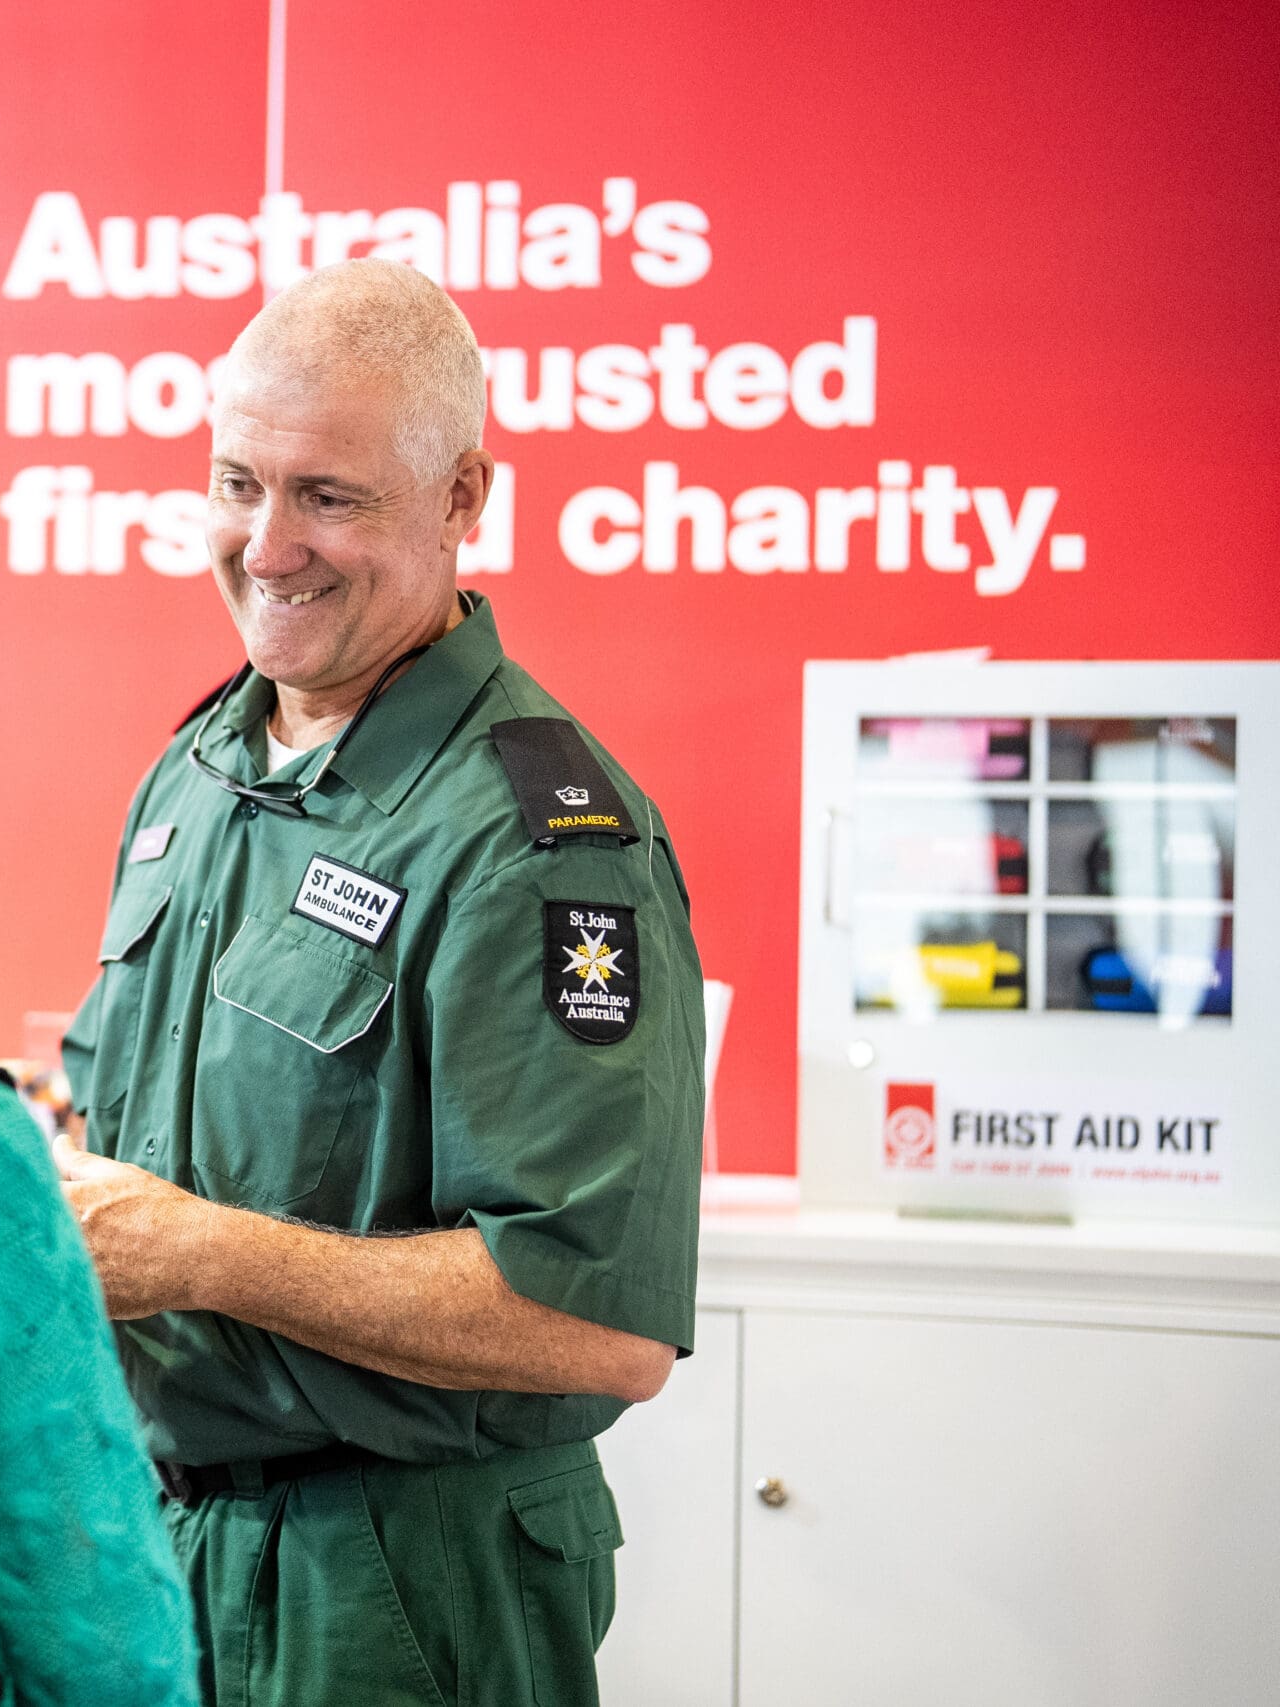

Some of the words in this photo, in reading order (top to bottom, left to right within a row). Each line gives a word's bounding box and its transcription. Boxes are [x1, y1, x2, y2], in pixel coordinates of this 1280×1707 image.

[1, 177, 712, 299] Australia's
[6, 352, 226, 438] mo
[478, 315, 878, 433] usted
[1, 465, 211, 577] firs
[557, 460, 1087, 596] charity.
[547, 815, 620, 829] PARAMEDIC
[303, 891, 378, 932] AMBULANCE
[311, 868, 334, 890] ST
[333, 879, 389, 916] JOHN
[570, 910, 585, 927] St
[585, 911, 617, 930] John
[558, 988, 630, 1008] Ambulance
[566, 1004, 625, 1023] Australia
[950, 1108, 1061, 1148] FIRST
[1073, 1112, 1142, 1152] AID
[1155, 1115, 1221, 1155] KIT
